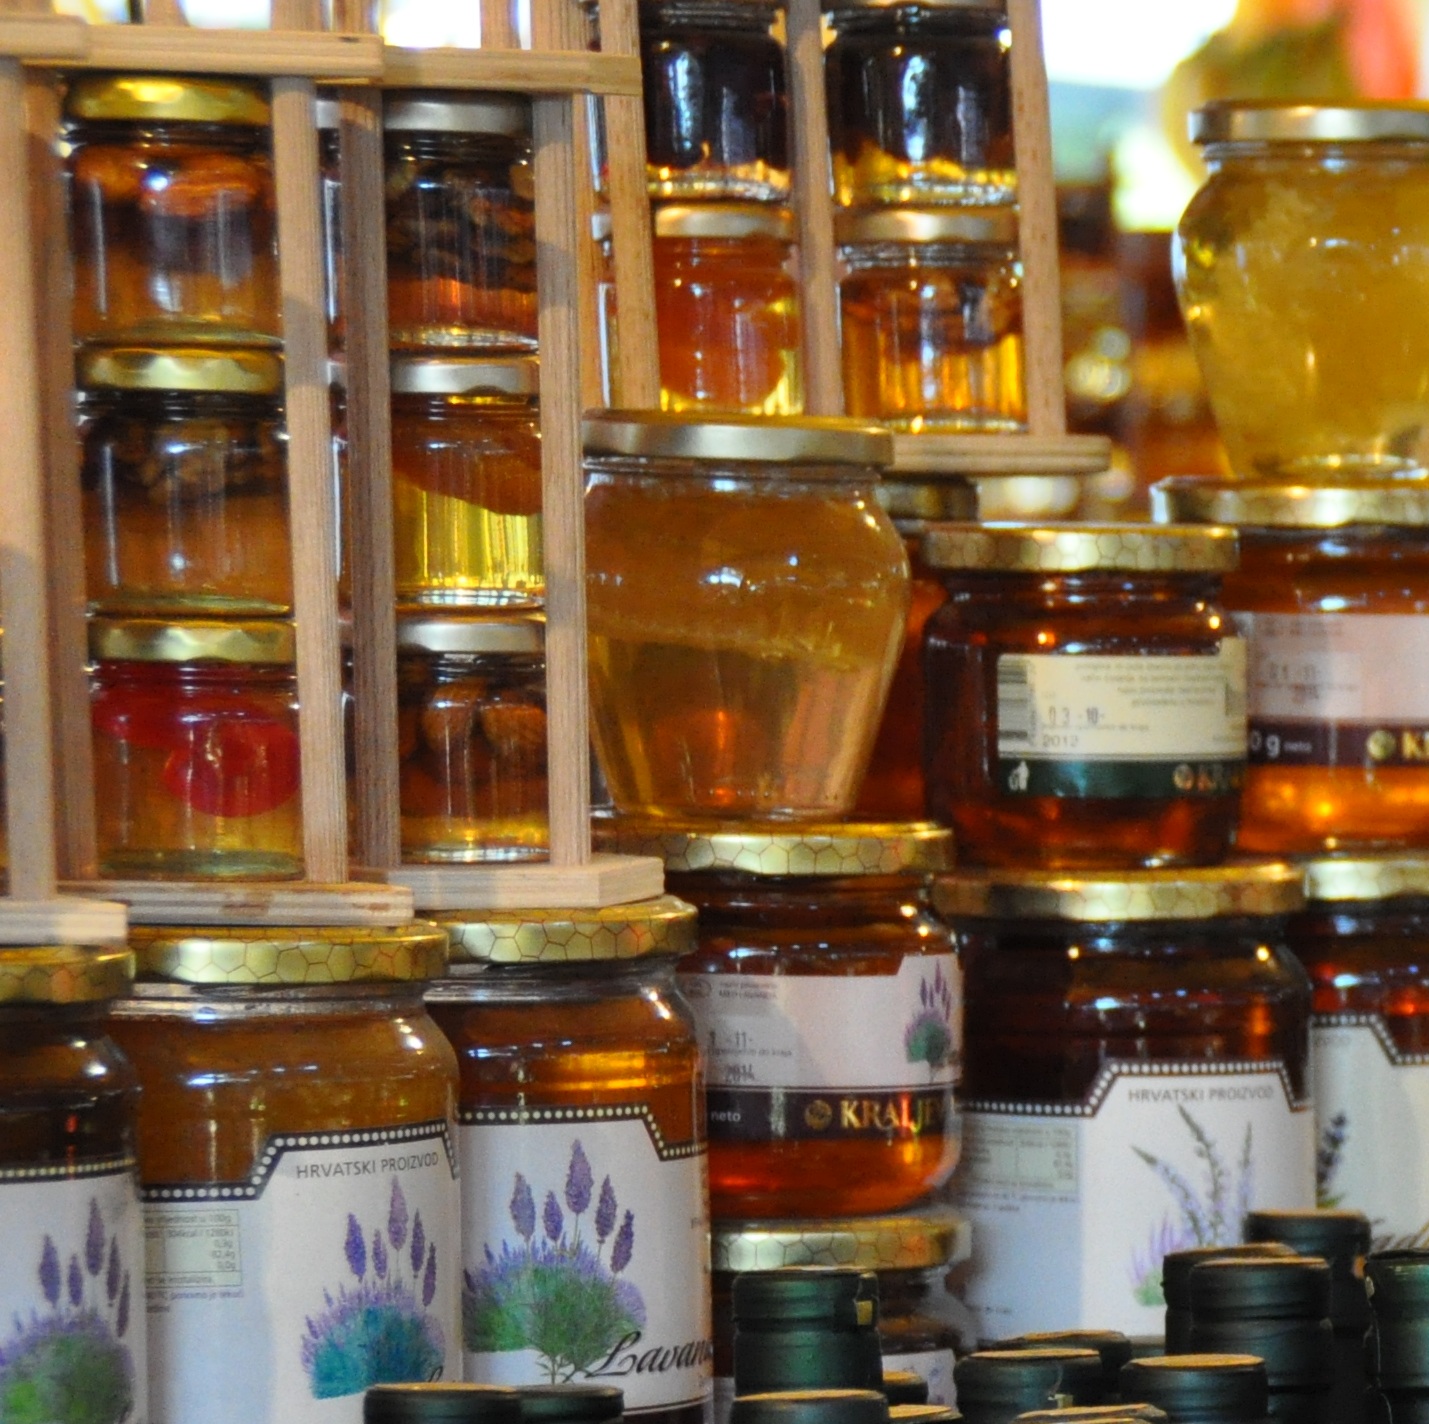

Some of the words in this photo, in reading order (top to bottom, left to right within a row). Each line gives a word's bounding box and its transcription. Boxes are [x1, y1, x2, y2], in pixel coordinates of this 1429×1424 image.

[1128, 1087, 1204, 1102] HRVATSKI
[710, 1111, 741, 1123] neto
[296, 1159, 376, 1179] HRVATSKI
[381, 1151, 439, 1172] PROIZVOD
